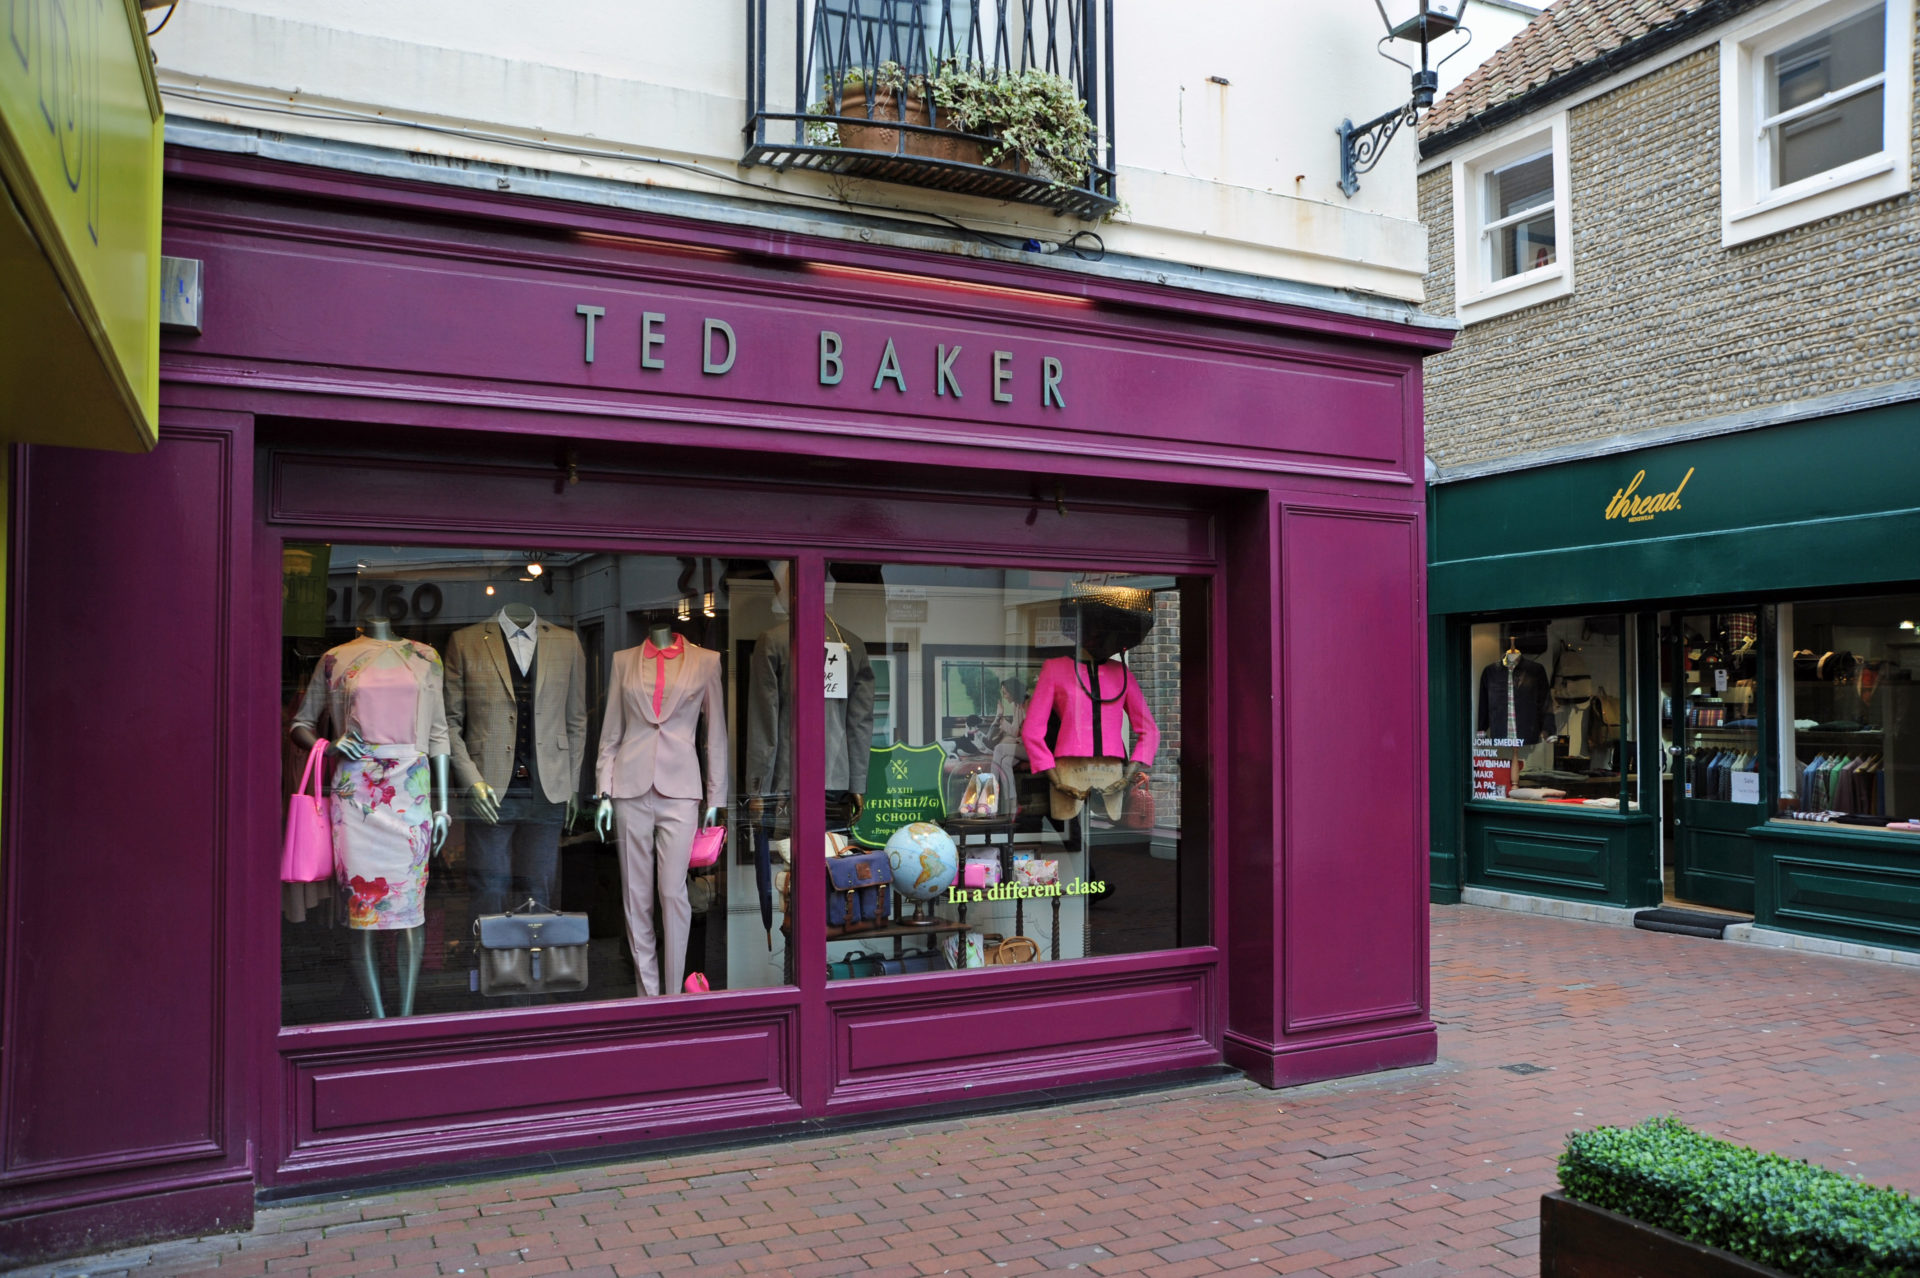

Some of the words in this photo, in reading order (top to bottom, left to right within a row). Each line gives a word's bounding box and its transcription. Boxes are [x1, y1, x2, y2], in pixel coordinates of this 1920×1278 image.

[576, 304, 737, 375] TED
[819, 330, 1066, 408] BAKER
[1473, 738, 1493, 747] JOHN
[1493, 738, 1525, 747] SMEDLEY
[1473, 748, 1498, 757] TUKTUK
[1473, 759, 1511, 769] LAVENHAM
[1473, 770, 1494, 779] MAKR
[1473, 781, 1482, 789] LA
[1483, 781, 1497, 790] PAZ
[875, 812, 923, 823] SCHOOL
[948, 886, 969, 904] In
[972, 888, 984, 902] a
[987, 881, 1062, 901] different
[1066, 877, 1106, 896] class
